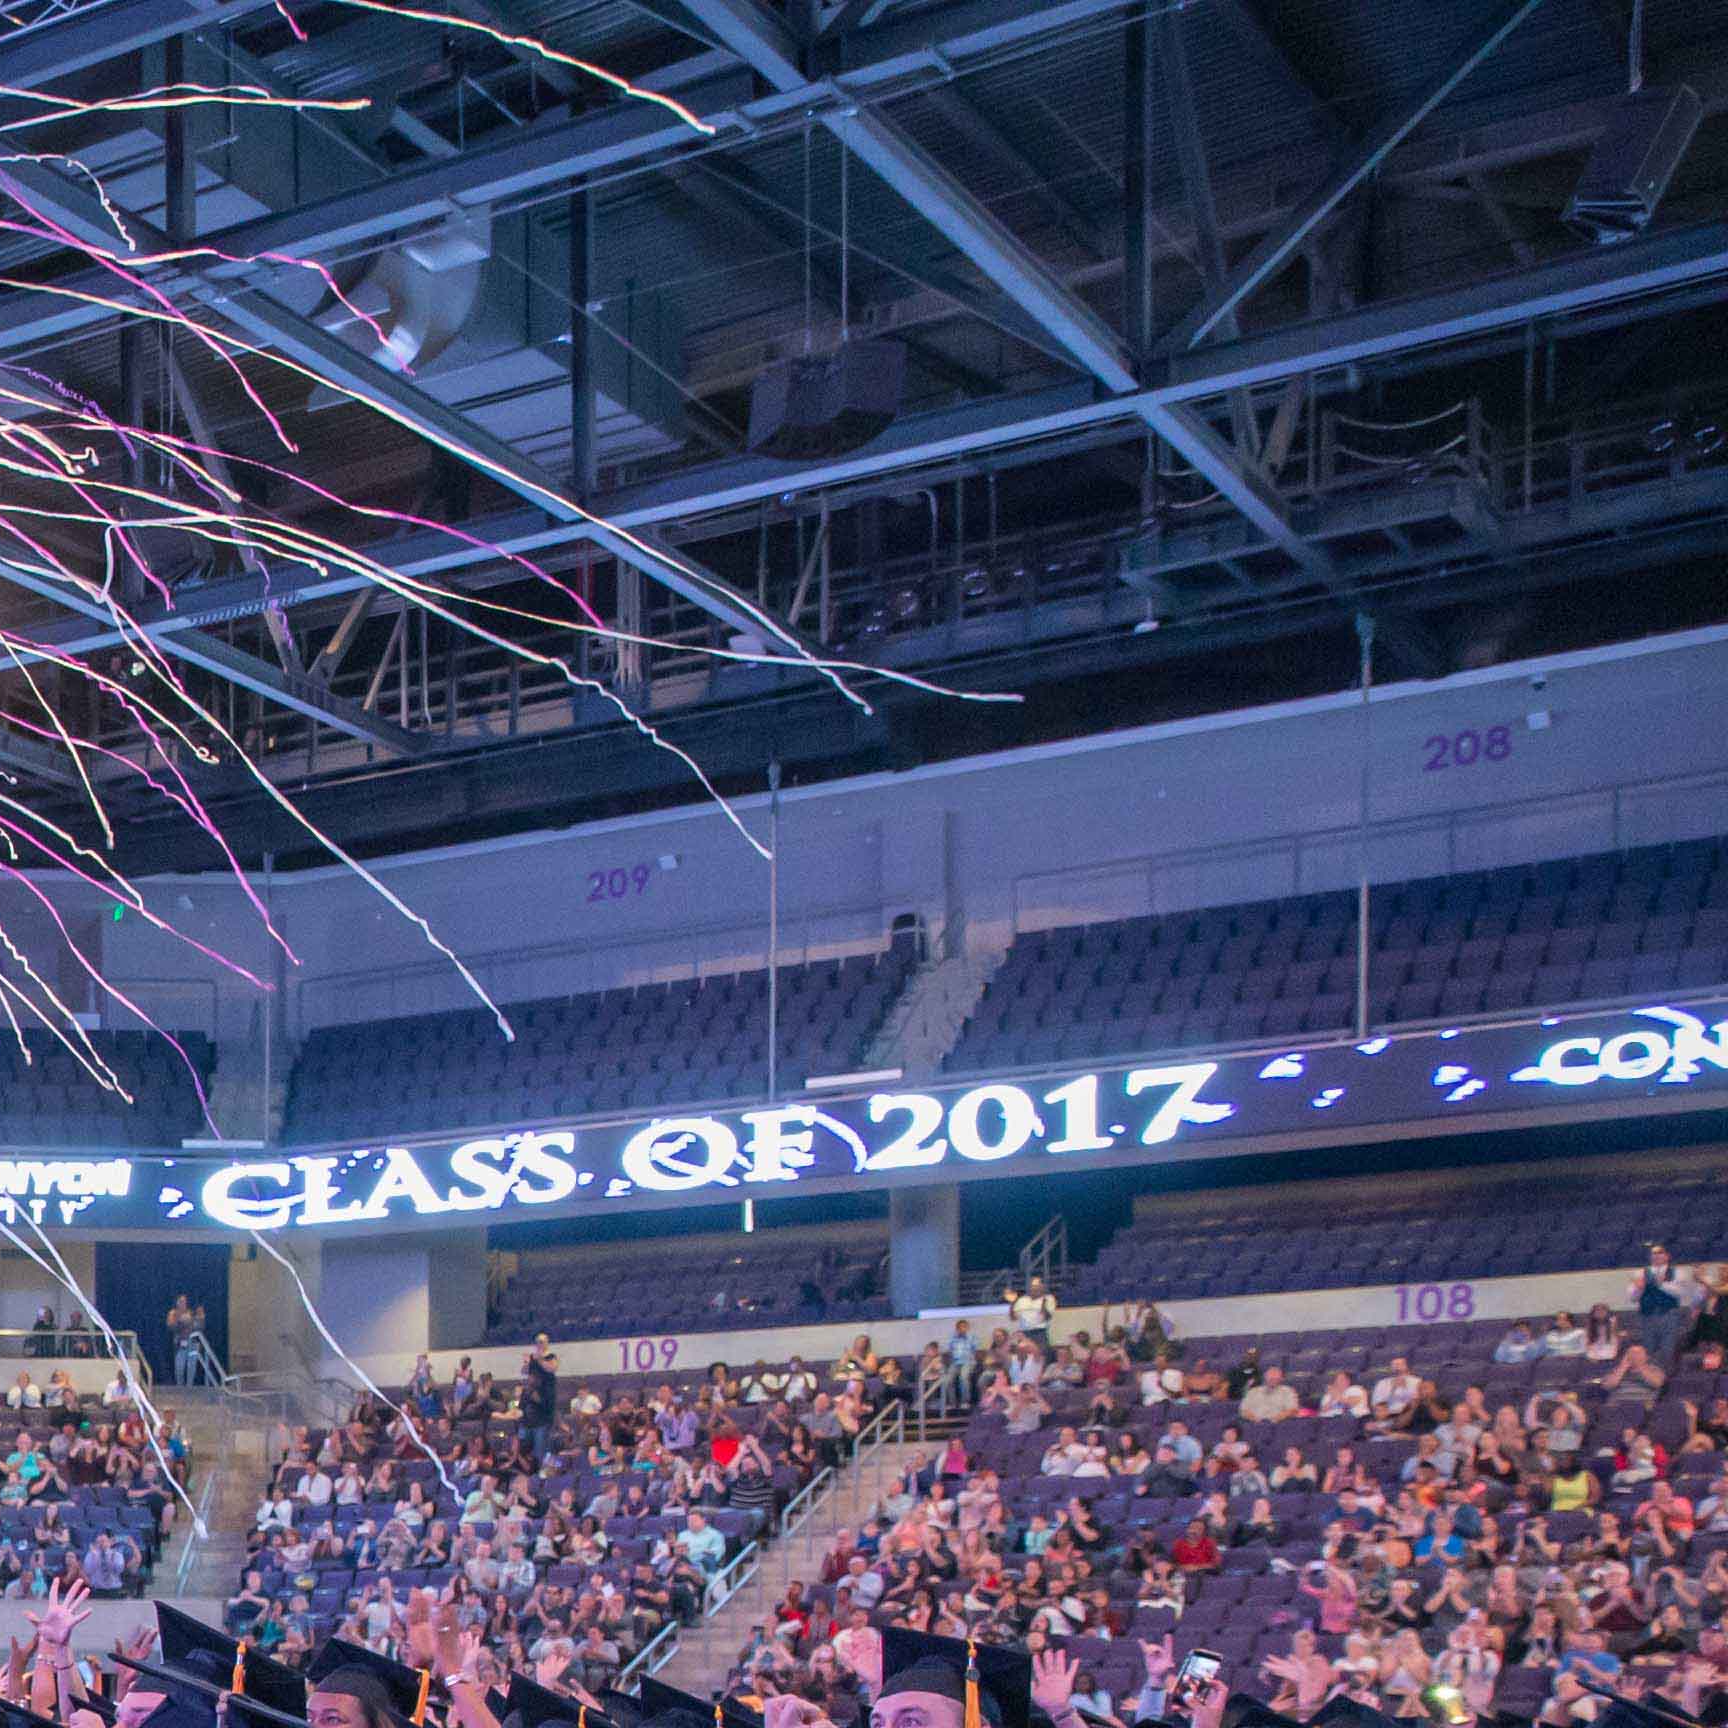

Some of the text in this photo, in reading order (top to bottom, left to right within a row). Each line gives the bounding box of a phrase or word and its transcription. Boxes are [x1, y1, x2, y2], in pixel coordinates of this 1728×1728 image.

[1422, 725, 1513, 773] 208
[585, 864, 651, 903] 209
[201, 1062, 1219, 1230] CLASS OF 2017
[1394, 1282, 1475, 1323] 108
[618, 1338, 680, 1372] 109
